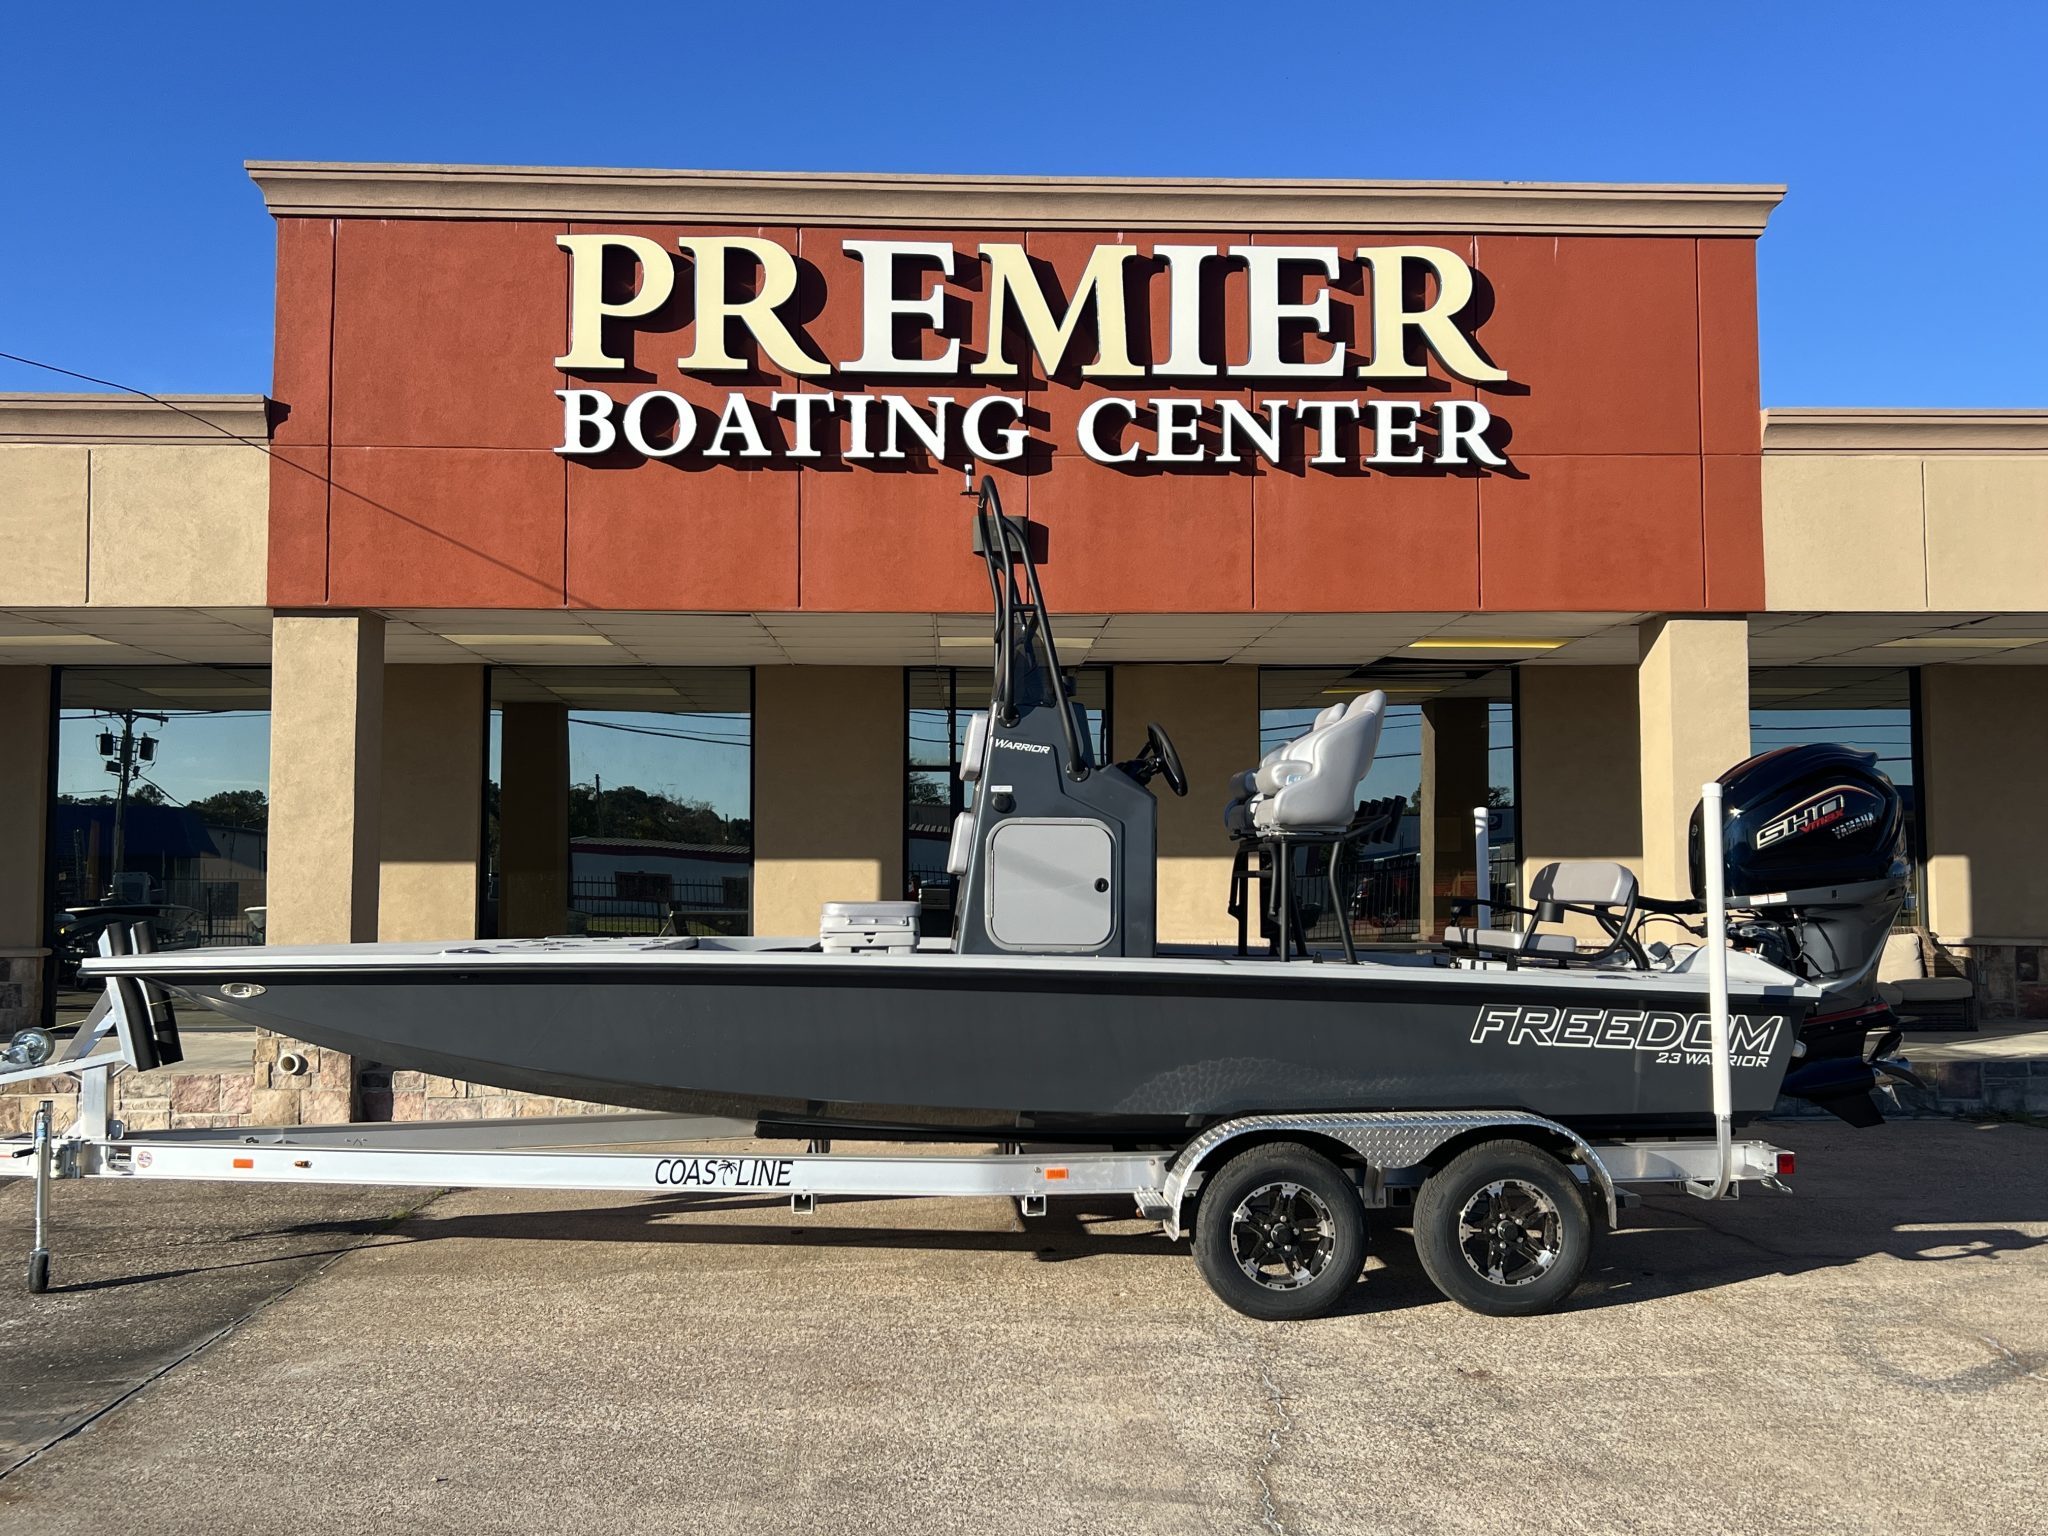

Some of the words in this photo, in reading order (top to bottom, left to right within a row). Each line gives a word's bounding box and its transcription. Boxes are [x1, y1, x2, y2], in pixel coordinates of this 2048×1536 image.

[554, 234, 1508, 382] PREMIER
[553, 389, 1031, 462] BOATING
[1076, 397, 1507, 466] CENTER
[994, 738, 1051, 754] WARRIOR
[1756, 794, 1844, 849] SHO
[1832, 812, 1876, 839] YAMAHA
[1470, 1003, 1783, 1055] FREEDOM
[1655, 1052, 1681, 1065] 23
[1686, 1053, 1769, 1068] WARIOR
